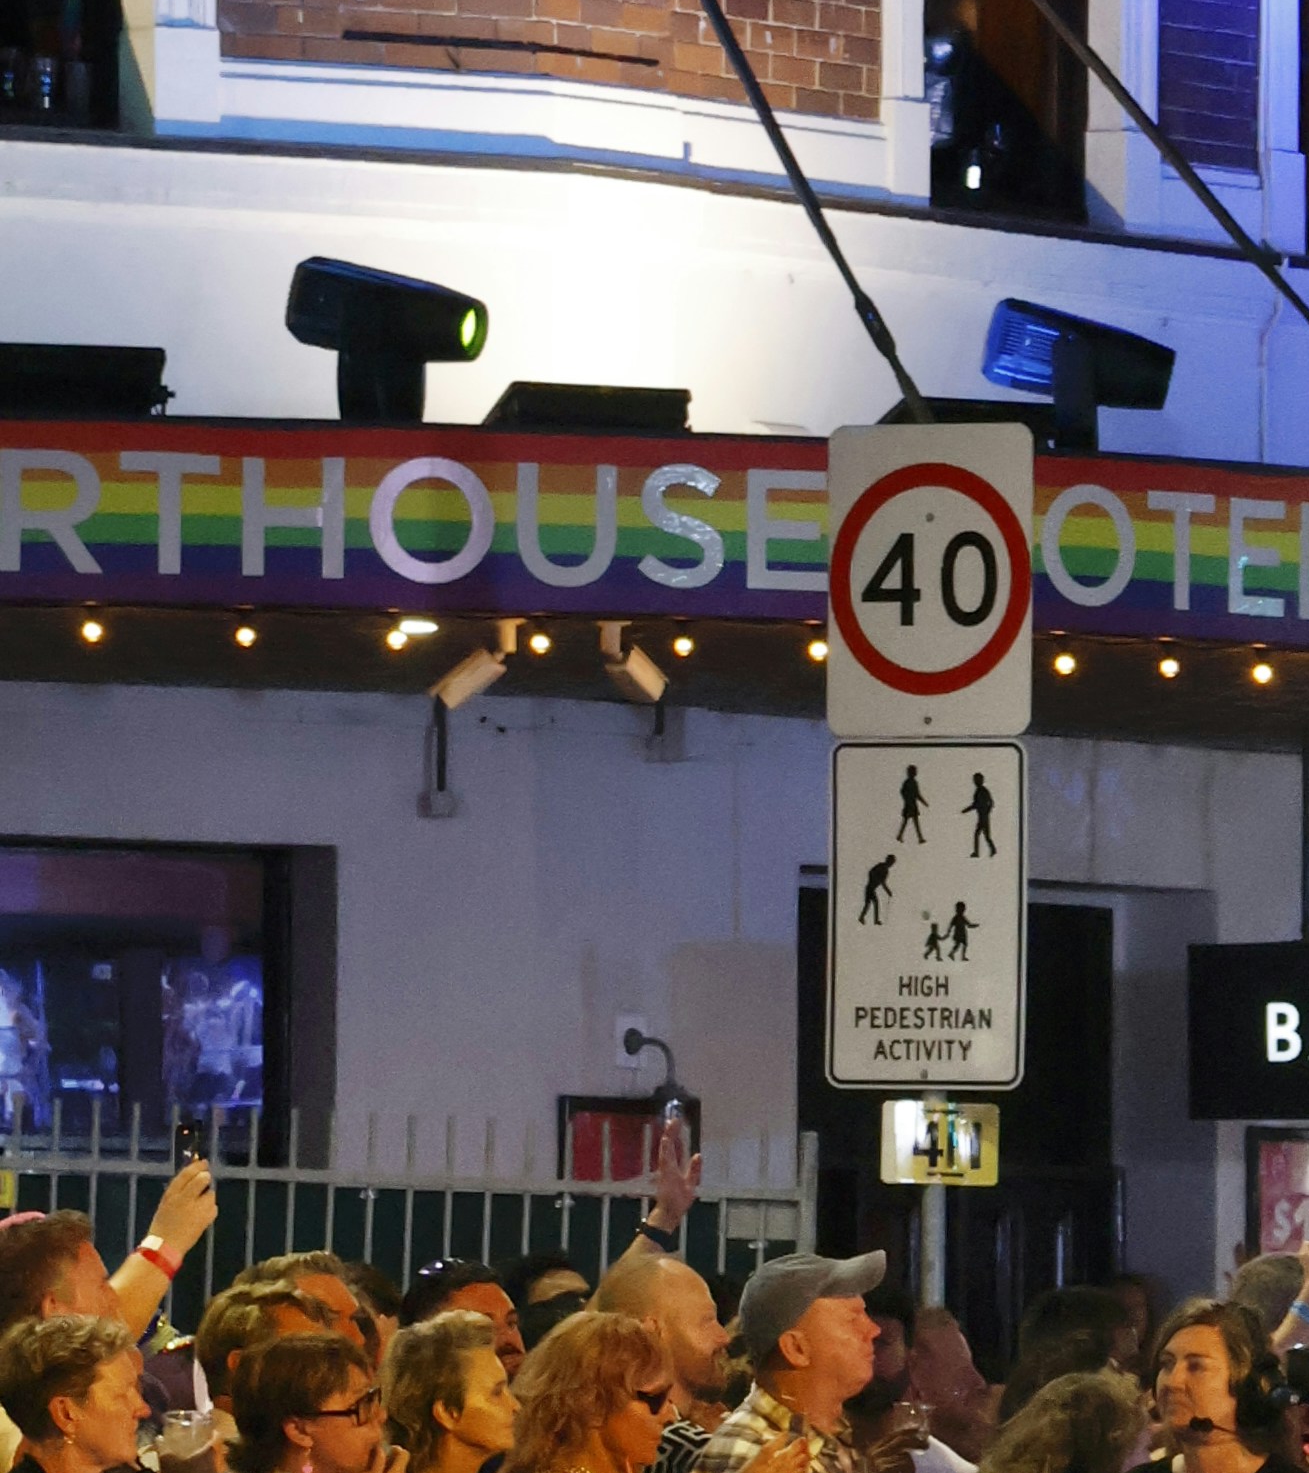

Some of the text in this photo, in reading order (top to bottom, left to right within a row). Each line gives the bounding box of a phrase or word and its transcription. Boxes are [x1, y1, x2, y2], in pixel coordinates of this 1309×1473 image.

[862, 531, 998, 628] 40
[898, 974, 951, 999] HIGH
[854, 1006, 993, 1031] PEDESTRIAN
[873, 1038, 974, 1064] ACTIVITY
